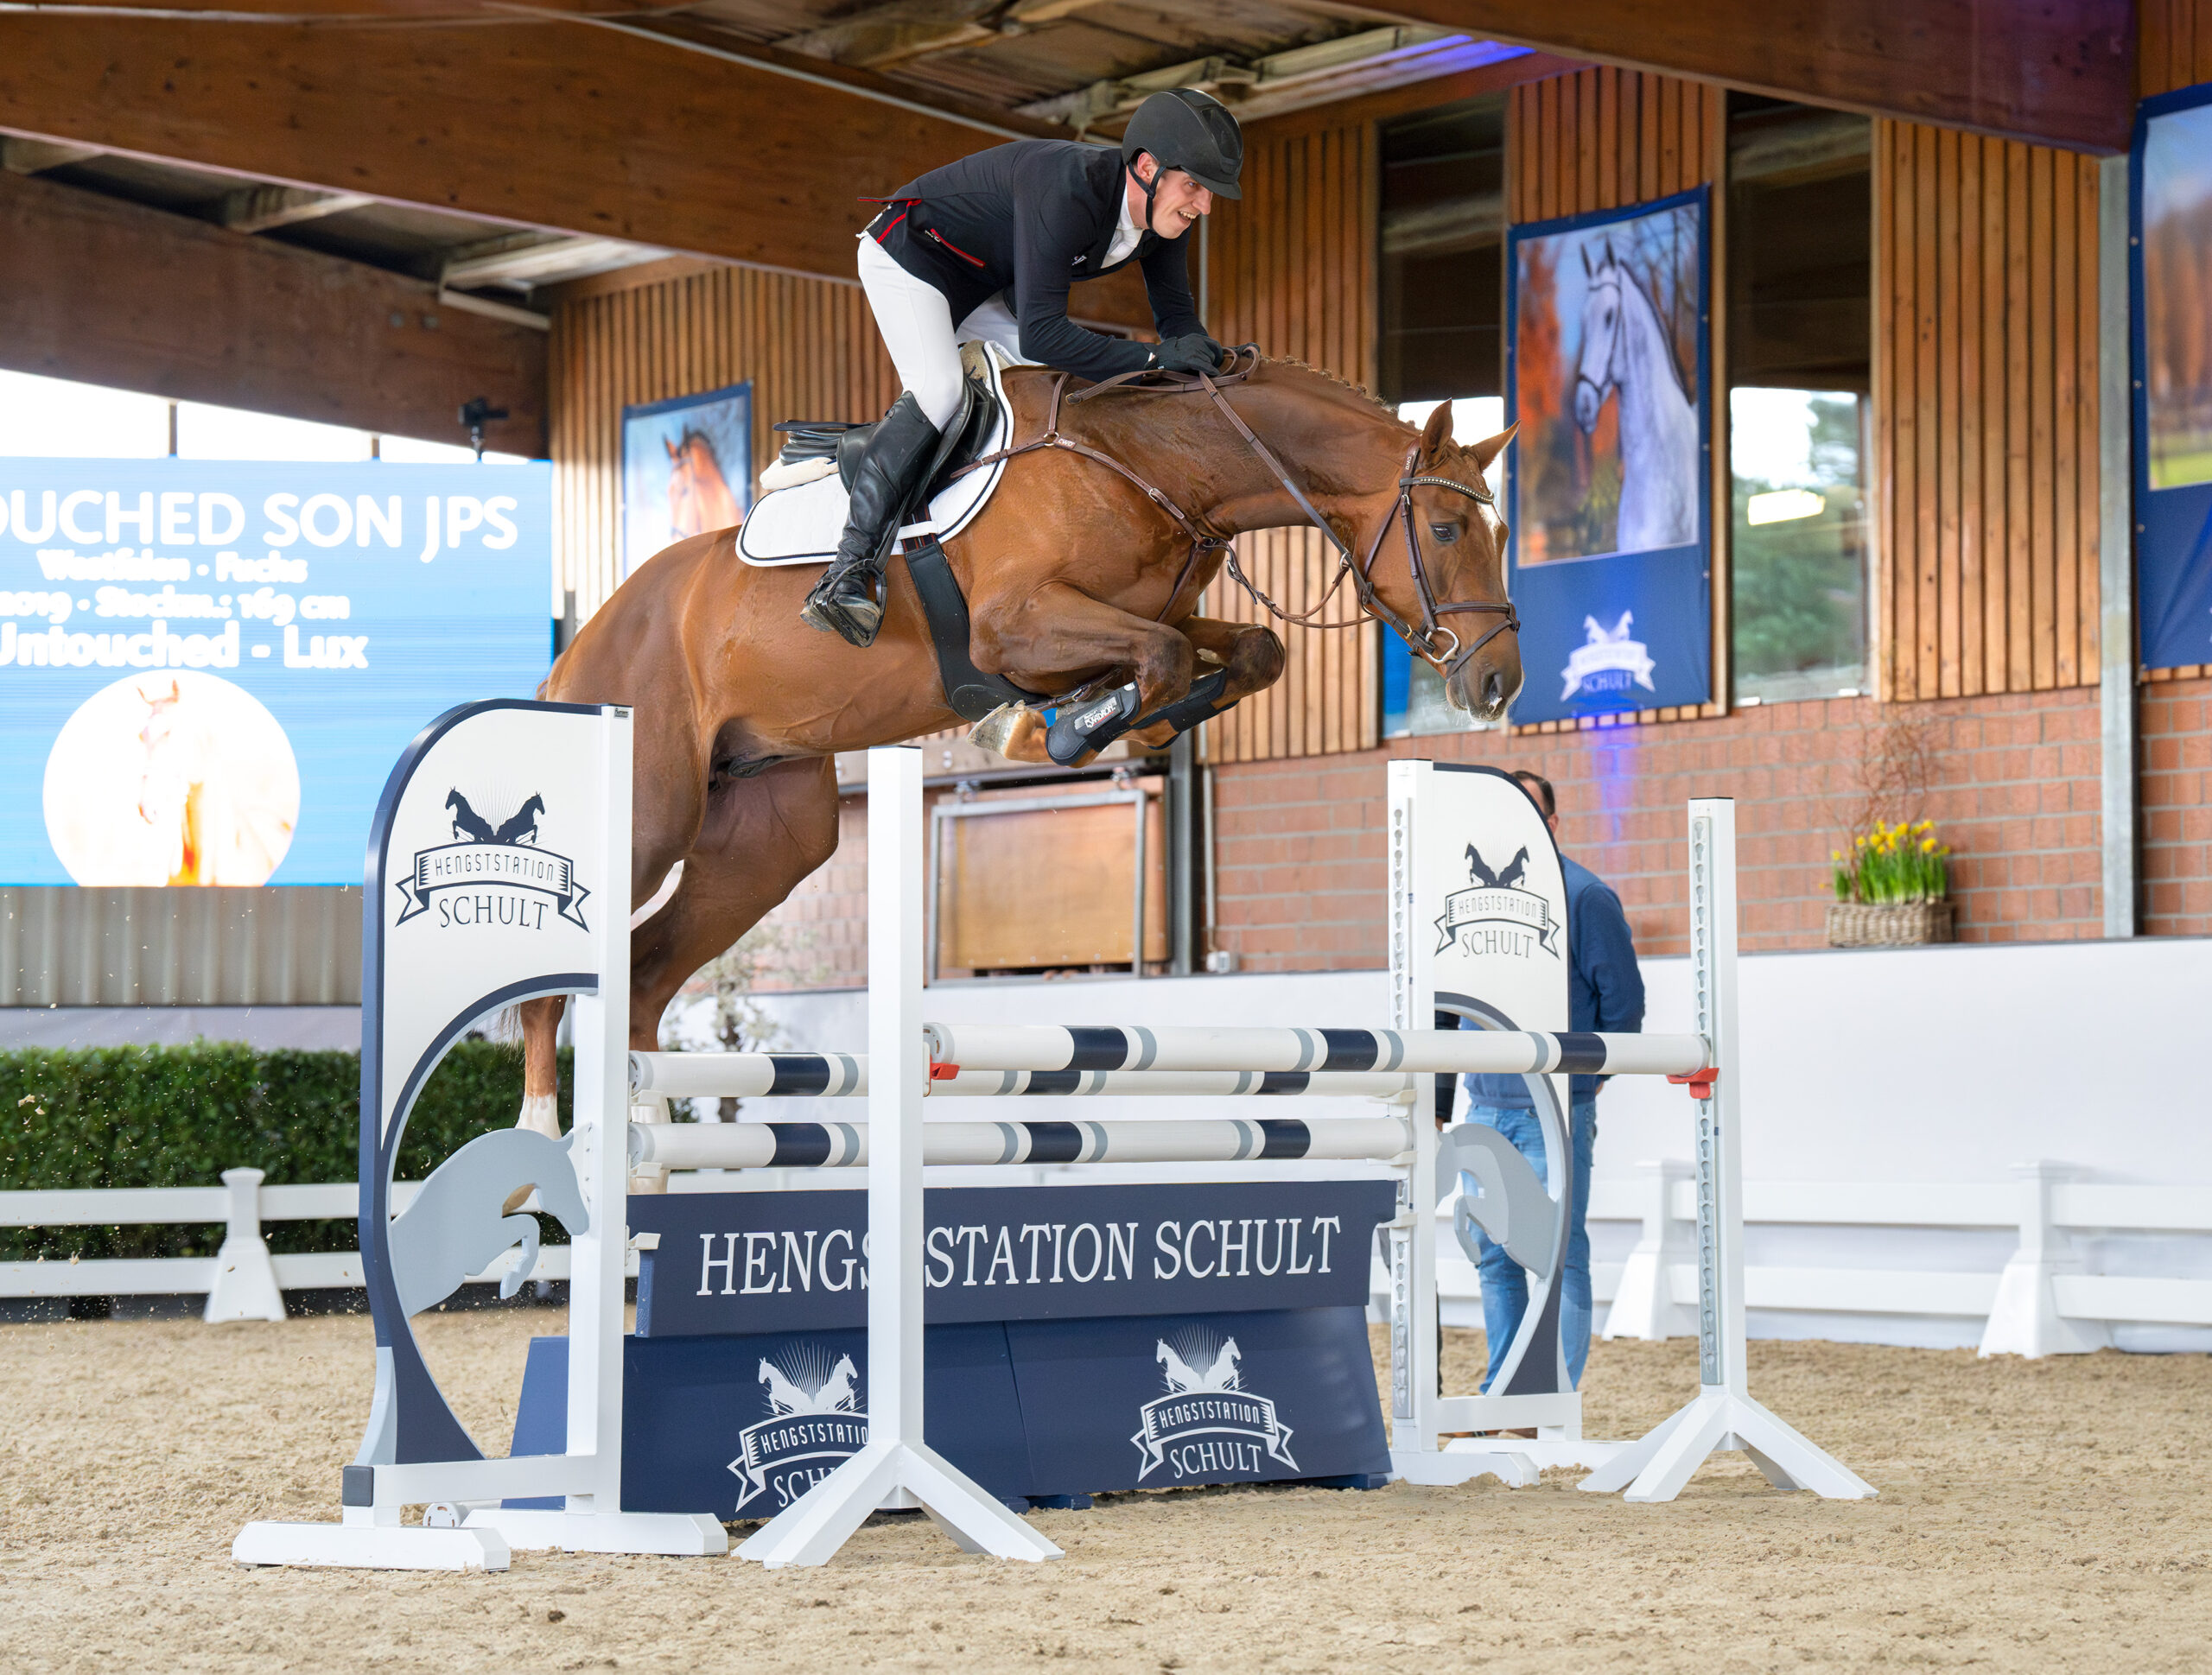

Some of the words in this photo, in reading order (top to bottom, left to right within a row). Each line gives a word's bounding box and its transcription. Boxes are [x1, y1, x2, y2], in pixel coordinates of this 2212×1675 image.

[0, 490, 245, 545] UCHED
[263, 493, 402, 548] SON
[421, 496, 518, 563] JPS
[216, 550, 308, 583] Fuchs
[300, 596, 350, 619] cm
[283, 625, 369, 669] Lux
[435, 853, 554, 881] HENGSTSTATION
[439, 895, 549, 930] SCHULT
[1459, 896, 1536, 918] HENGSTSTATION
[1462, 930, 1534, 959] SCHULT
[696, 1223, 1139, 1296] HENGSTATION
[1154, 1215, 1341, 1280] SCHULT
[1159, 1401, 1260, 1428] HENGSTSTATION
[760, 1424, 868, 1454] HENGSTSTATIO
[1170, 1443, 1262, 1479] SCHULT
